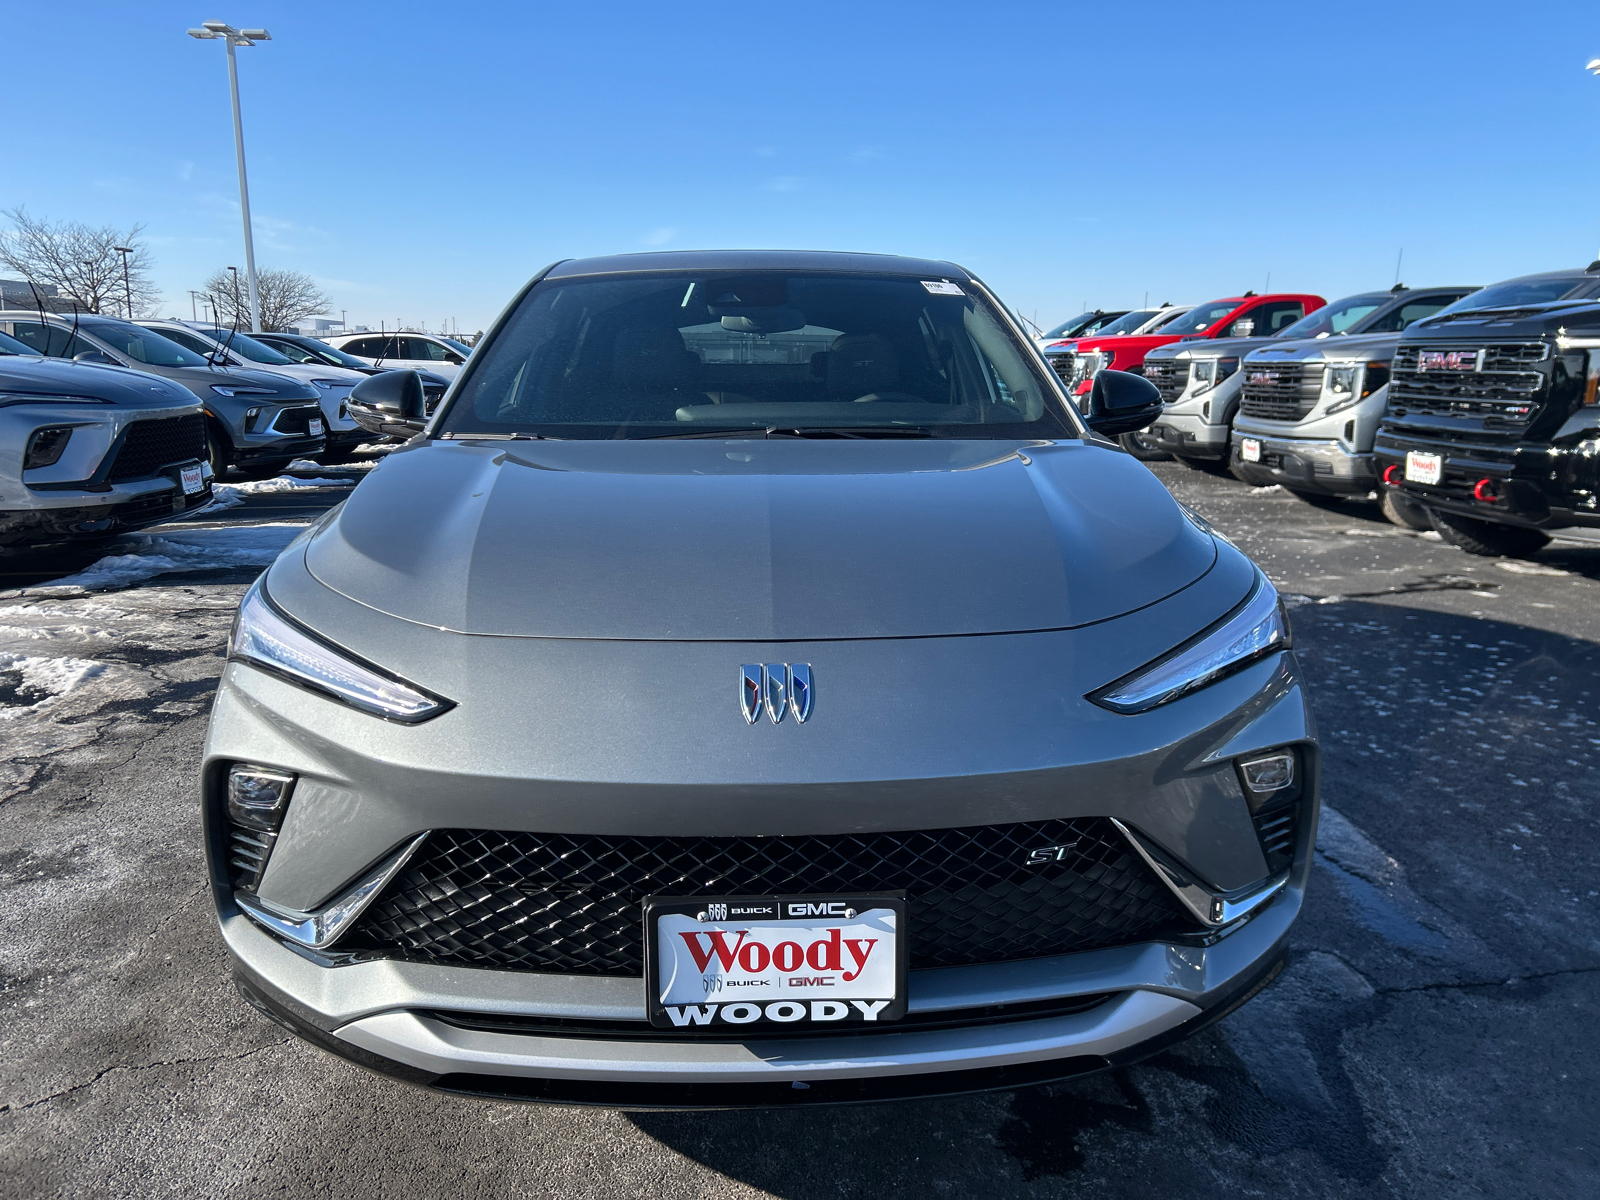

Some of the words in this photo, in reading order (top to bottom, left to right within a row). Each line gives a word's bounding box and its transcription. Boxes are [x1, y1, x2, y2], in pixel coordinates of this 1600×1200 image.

[1419, 351, 1477, 370] GMC
[1411, 457, 1437, 474] Woody
[182, 471, 201, 484] Woody
[1025, 842, 1078, 865] ST
[788, 902, 846, 916] GMC
[678, 928, 879, 982] Woody
[788, 976, 836, 987] GMC
[664, 1000, 891, 1026] WOODY
